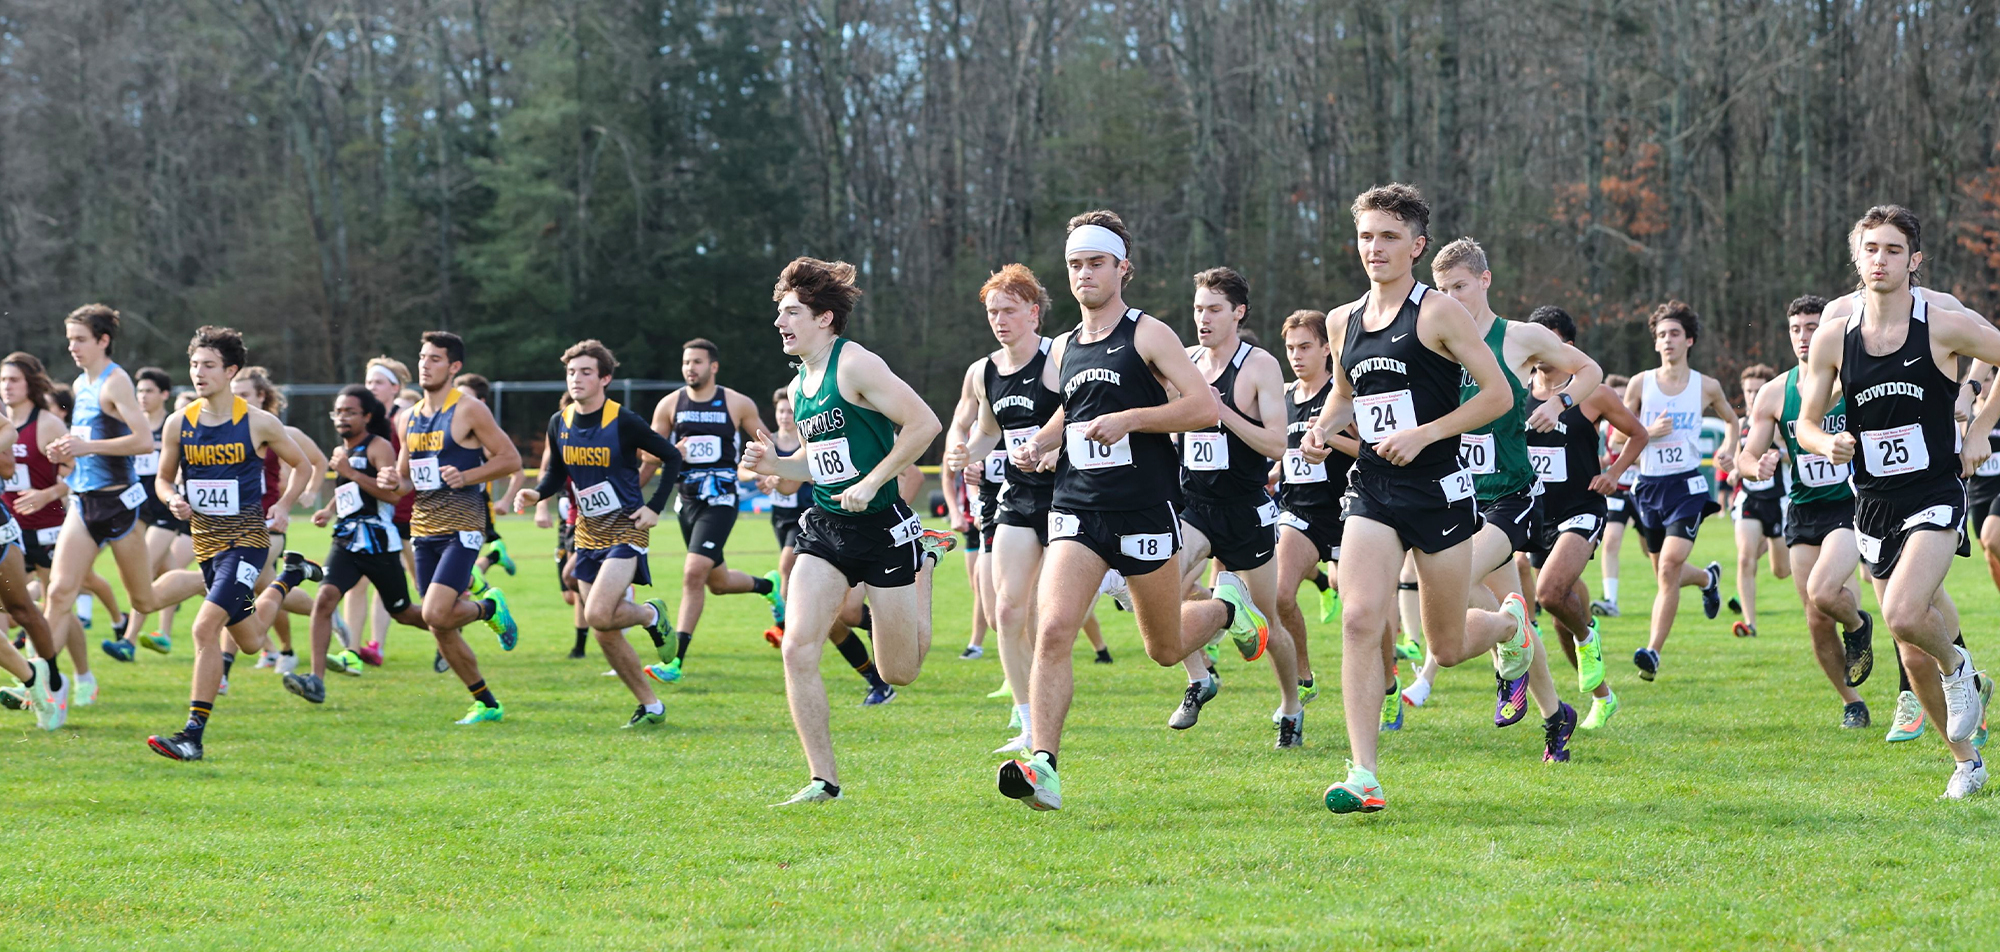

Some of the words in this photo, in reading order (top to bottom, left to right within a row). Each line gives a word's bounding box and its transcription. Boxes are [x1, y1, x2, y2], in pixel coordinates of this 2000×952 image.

[1350, 357, 1408, 385] BOWDOIN
[1064, 368, 1121, 399] BOWDOIN
[1854, 381, 1925, 408] BOWDOIN
[993, 394, 1034, 415] BOWDOIN
[796, 407, 846, 440] NICHOLS
[1371, 403, 1397, 433] 24
[184, 442, 247, 466] UMASSD
[562, 444, 612, 468] UMASSD
[690, 442, 714, 458] 236
[1193, 441, 1214, 463] 20
[1657, 447, 1684, 464] 132
[1878, 438, 1909, 467] 25
[814, 449, 845, 476] 168
[1532, 455, 1552, 475] 22
[1804, 460, 1837, 481] 171
[411, 466, 433, 484] 242
[196, 488, 229, 508] 244
[580, 490, 610, 512] 240
[1137, 538, 1158, 556] 18
